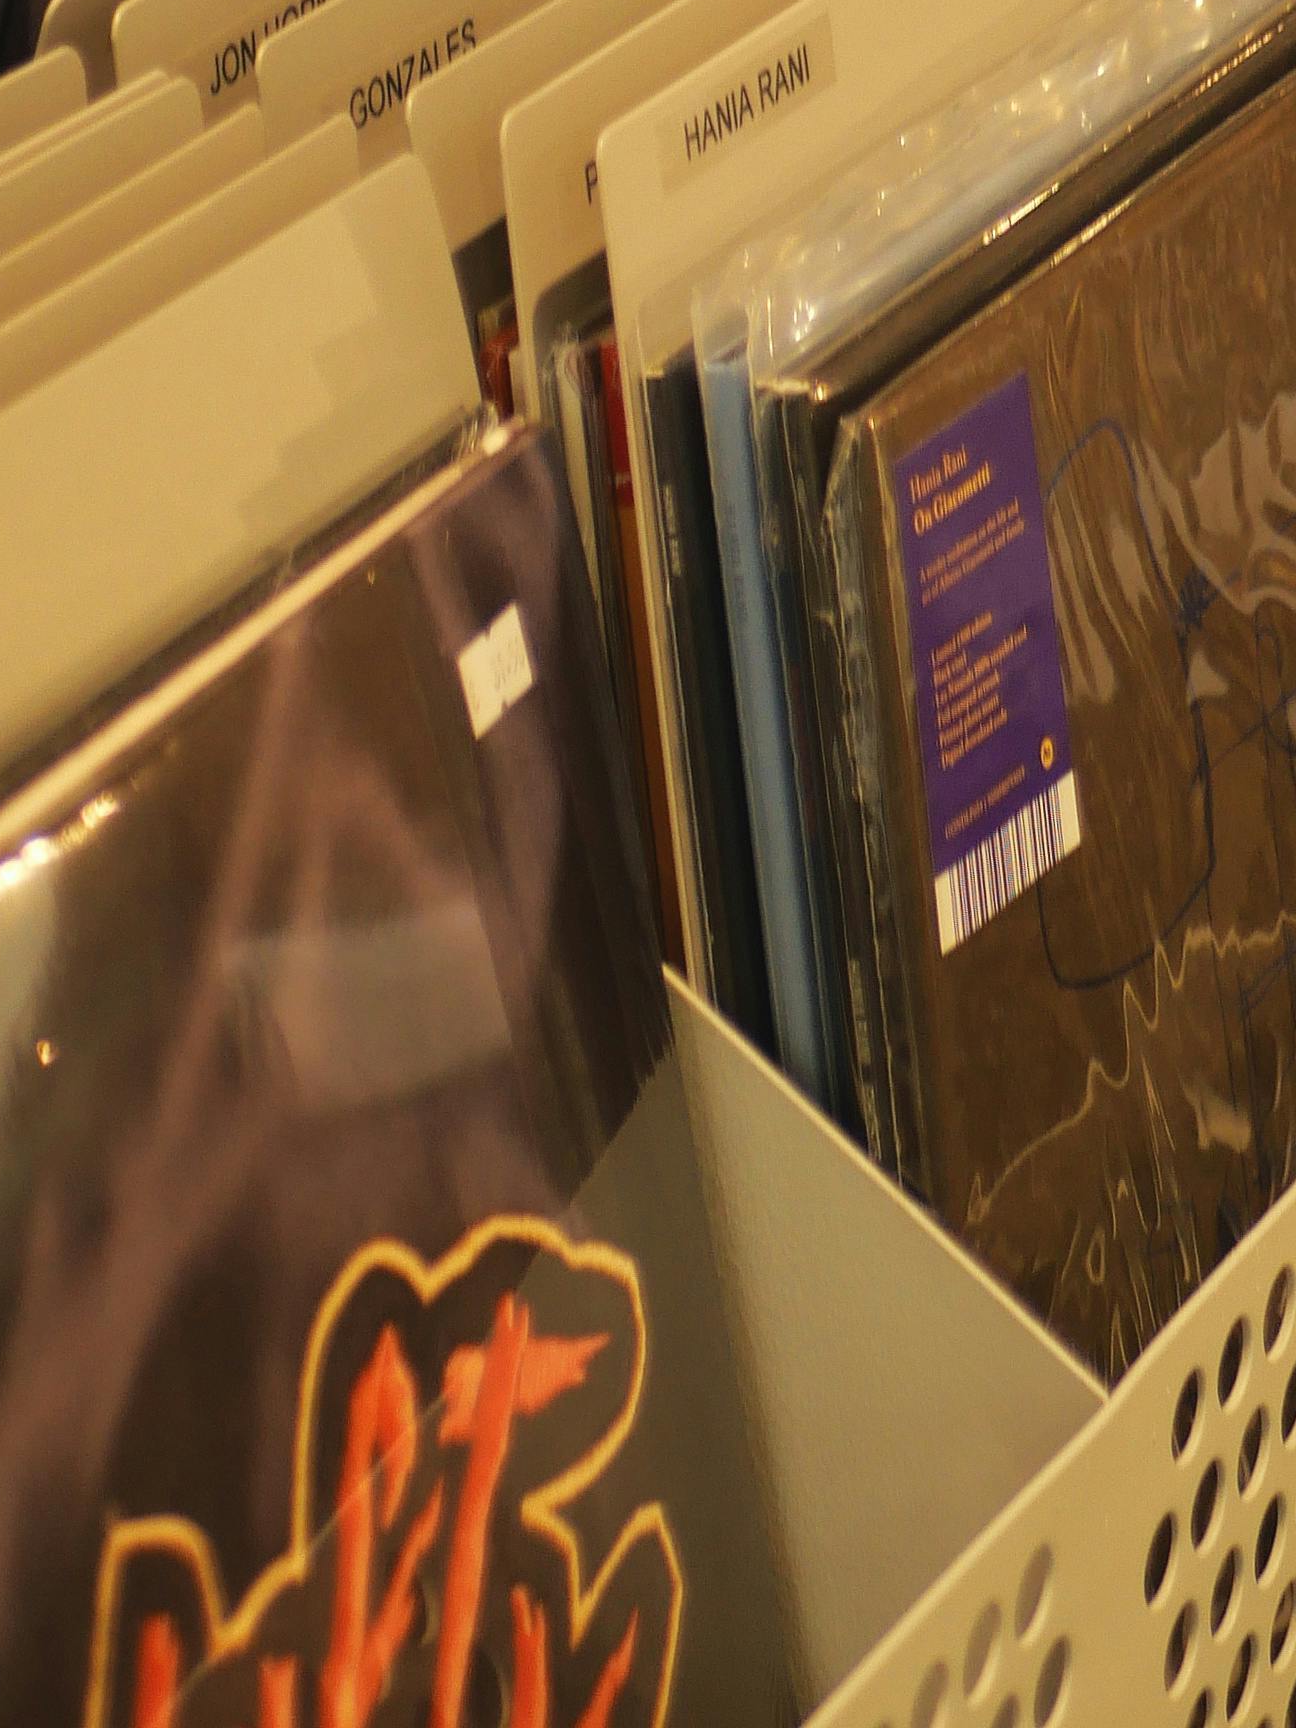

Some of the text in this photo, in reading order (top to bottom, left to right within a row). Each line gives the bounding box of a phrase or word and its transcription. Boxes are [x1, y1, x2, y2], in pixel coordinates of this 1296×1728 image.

[210, 29, 258, 97] JON
[683, 43, 811, 162] HANIA RANI
[910, 444, 967, 504] Hania Rani
[914, 461, 991, 536] On Giacometti
